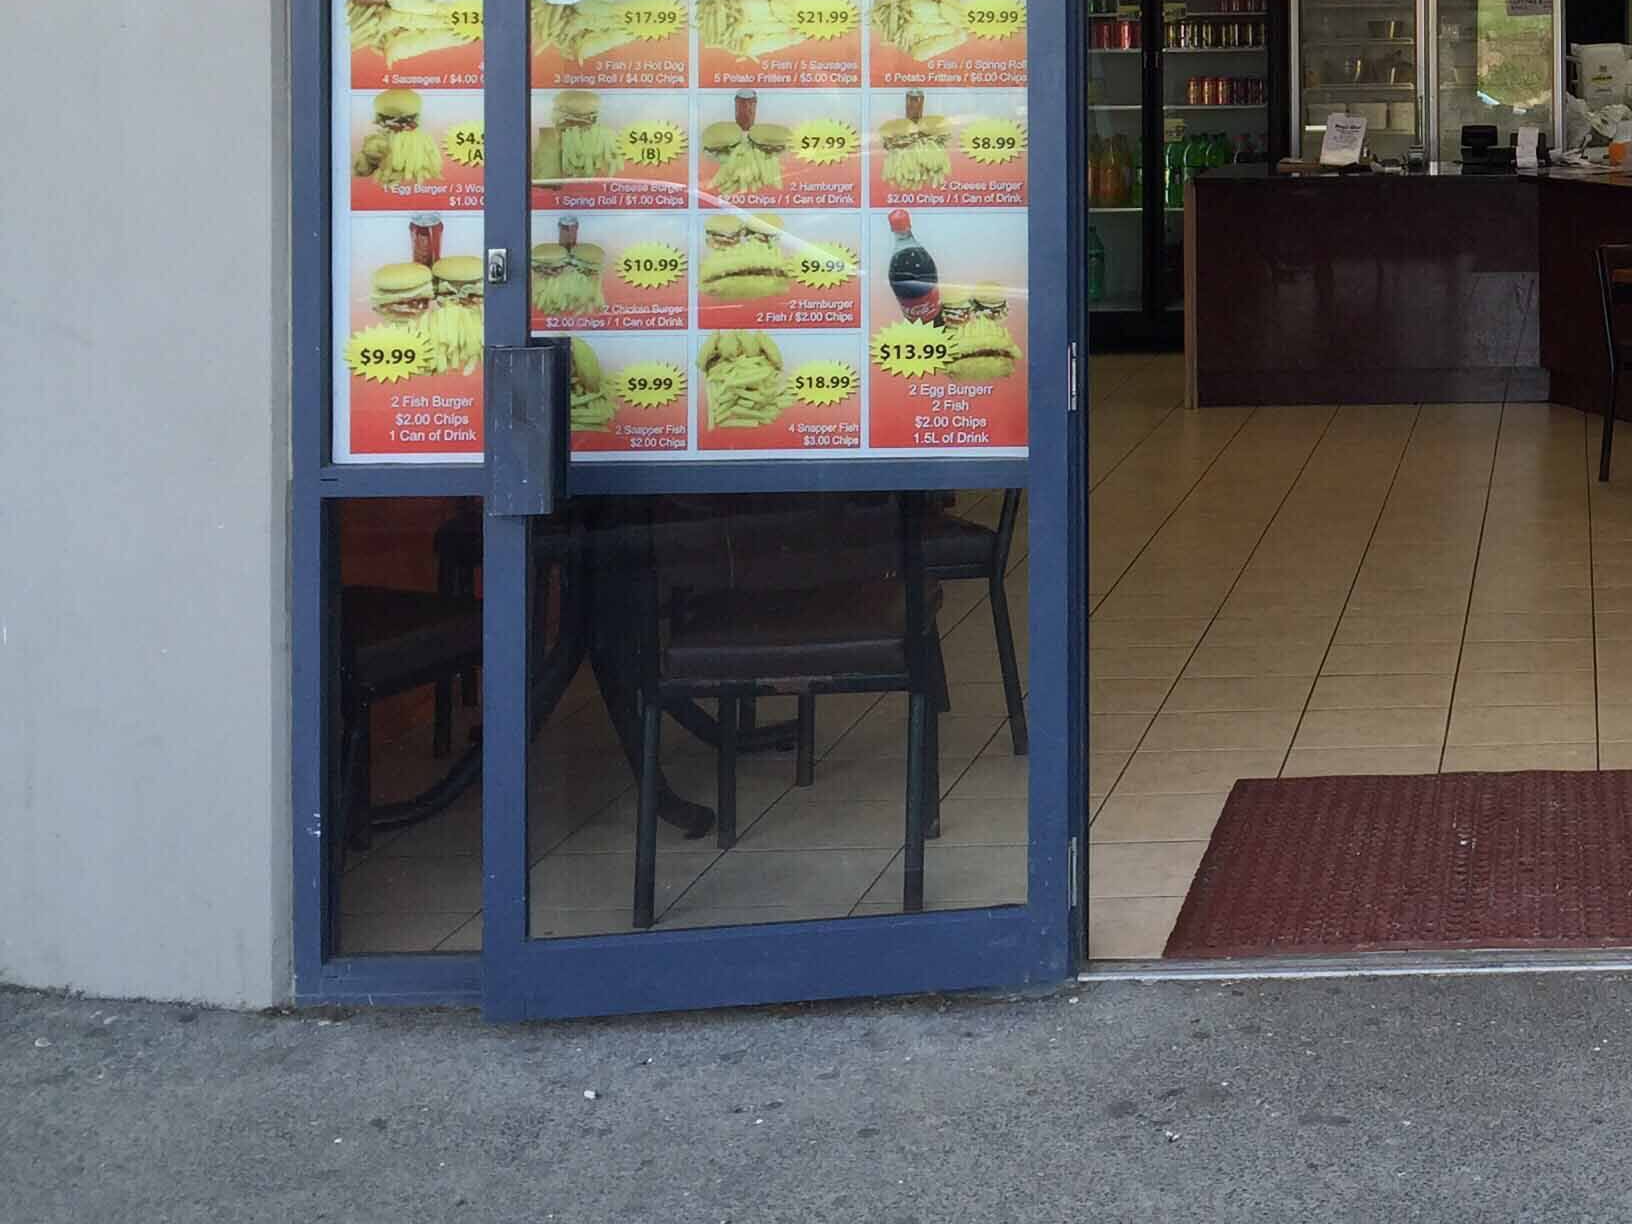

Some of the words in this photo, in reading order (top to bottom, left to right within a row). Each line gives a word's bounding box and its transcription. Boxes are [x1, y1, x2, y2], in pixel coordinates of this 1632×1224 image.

[625, 11, 677, 24] $17.99
[797, 10, 849, 24] $21.99
[968, 10, 1019, 24] $29.99
[630, 131, 673, 144] $4.99
[801, 135, 846, 150] $7.99
[972, 135, 1016, 150] $8.99
[641, 148, 661, 161] (B)
[392, 184, 411, 195] Egg
[414, 184, 447, 195] Burger
[563, 196, 595, 208] Spring
[656, 196, 684, 208] Chips
[747, 194, 776, 206] Chips
[793, 194, 814, 204] Can
[828, 194, 854, 204] Drink
[916, 194, 944, 205] Chips
[961, 194, 982, 203] Can
[624, 259, 678, 272] $10.99
[800, 259, 846, 273] $9.99
[799, 299, 853, 310] Hamburger
[622, 317, 643, 327] Can
[658, 317, 683, 327] Drink
[766, 313, 787, 322] Fish
[825, 313, 853, 324] Chips
[360, 347, 416, 367] $9.99
[880, 343, 947, 360] $13.99
[628, 377, 673, 391] $9.99
[795, 375, 850, 389] $18.99
[910, 384, 917, 395] 2
[920, 384, 944, 397] Egg
[391, 396, 399, 407] 2
[402, 396, 428, 407] Fish
[432, 396, 474, 409] Burger
[932, 400, 940, 411] 2
[944, 400, 969, 411] Fish
[396, 414, 431, 425] $2.00
[434, 414, 469, 427] Chips
[915, 416, 949, 427] $2.00
[952, 416, 987, 429] Chips
[390, 430, 395, 441] 1
[400, 430, 425, 441] Can
[429, 430, 441, 441] of
[444, 430, 477, 441] Drink
[914, 432, 940, 443] 1.5L
[943, 432, 954, 443] of
[957, 432, 989, 443] Drink
